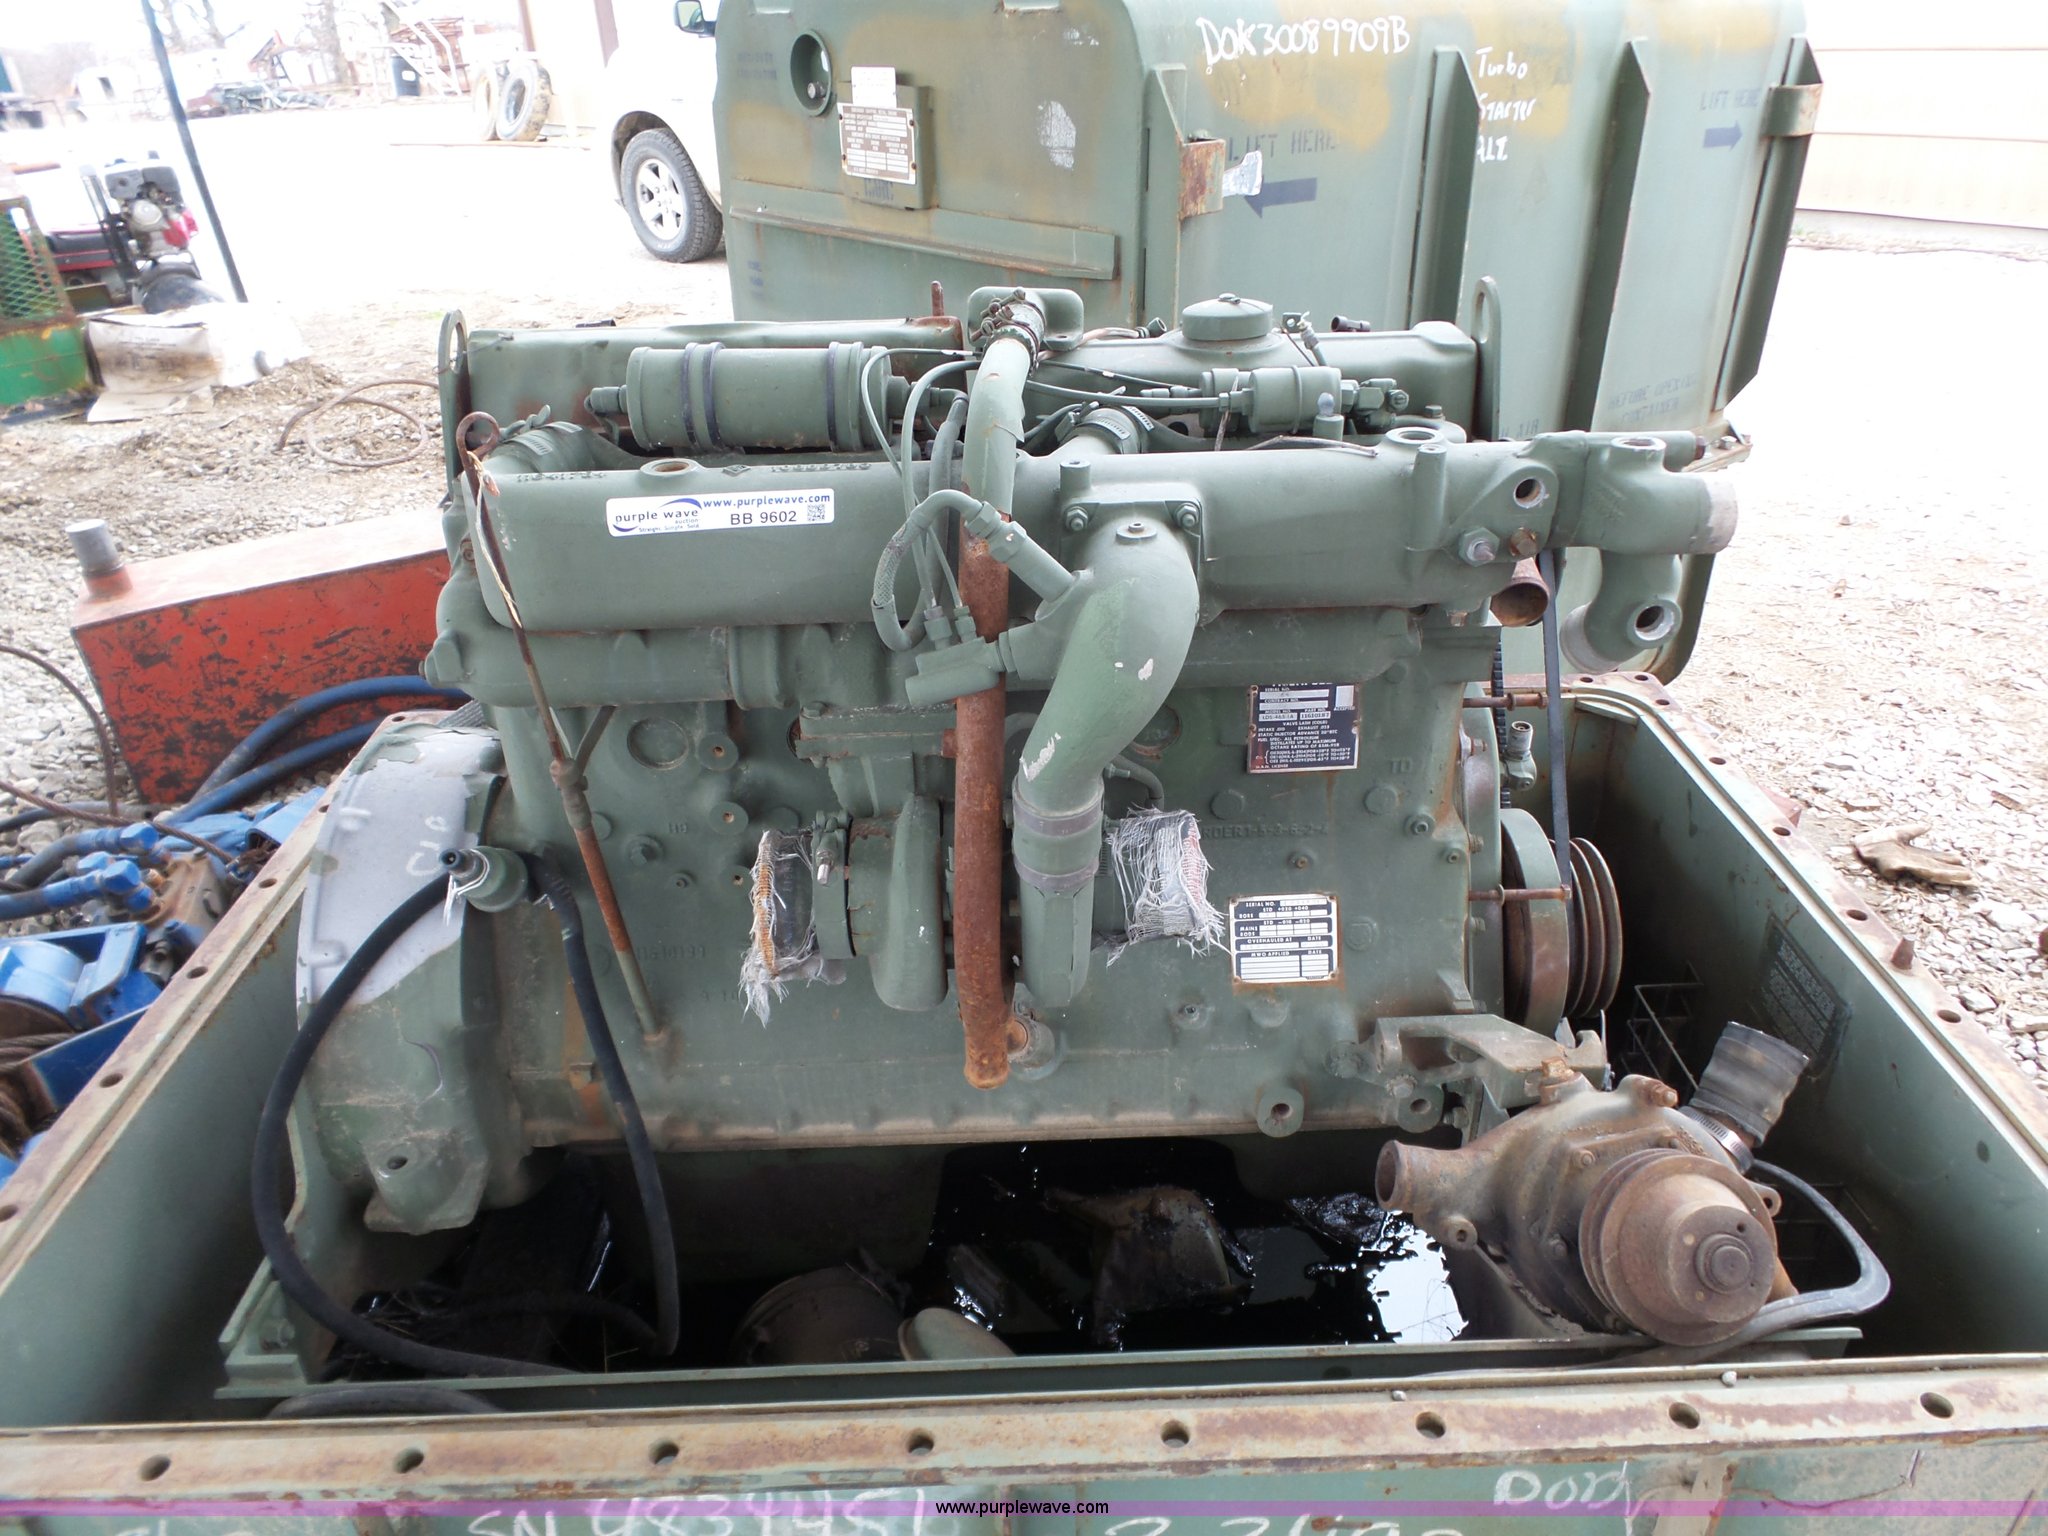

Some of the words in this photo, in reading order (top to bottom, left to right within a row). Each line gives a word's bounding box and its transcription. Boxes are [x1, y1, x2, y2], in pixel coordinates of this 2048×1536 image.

[703, 495, 830, 509] www.purplewave.com
[615, 511, 658, 525] purple
[664, 509, 698, 519] wave
[730, 512, 753, 525] BB
[760, 510, 797, 524] 9602
